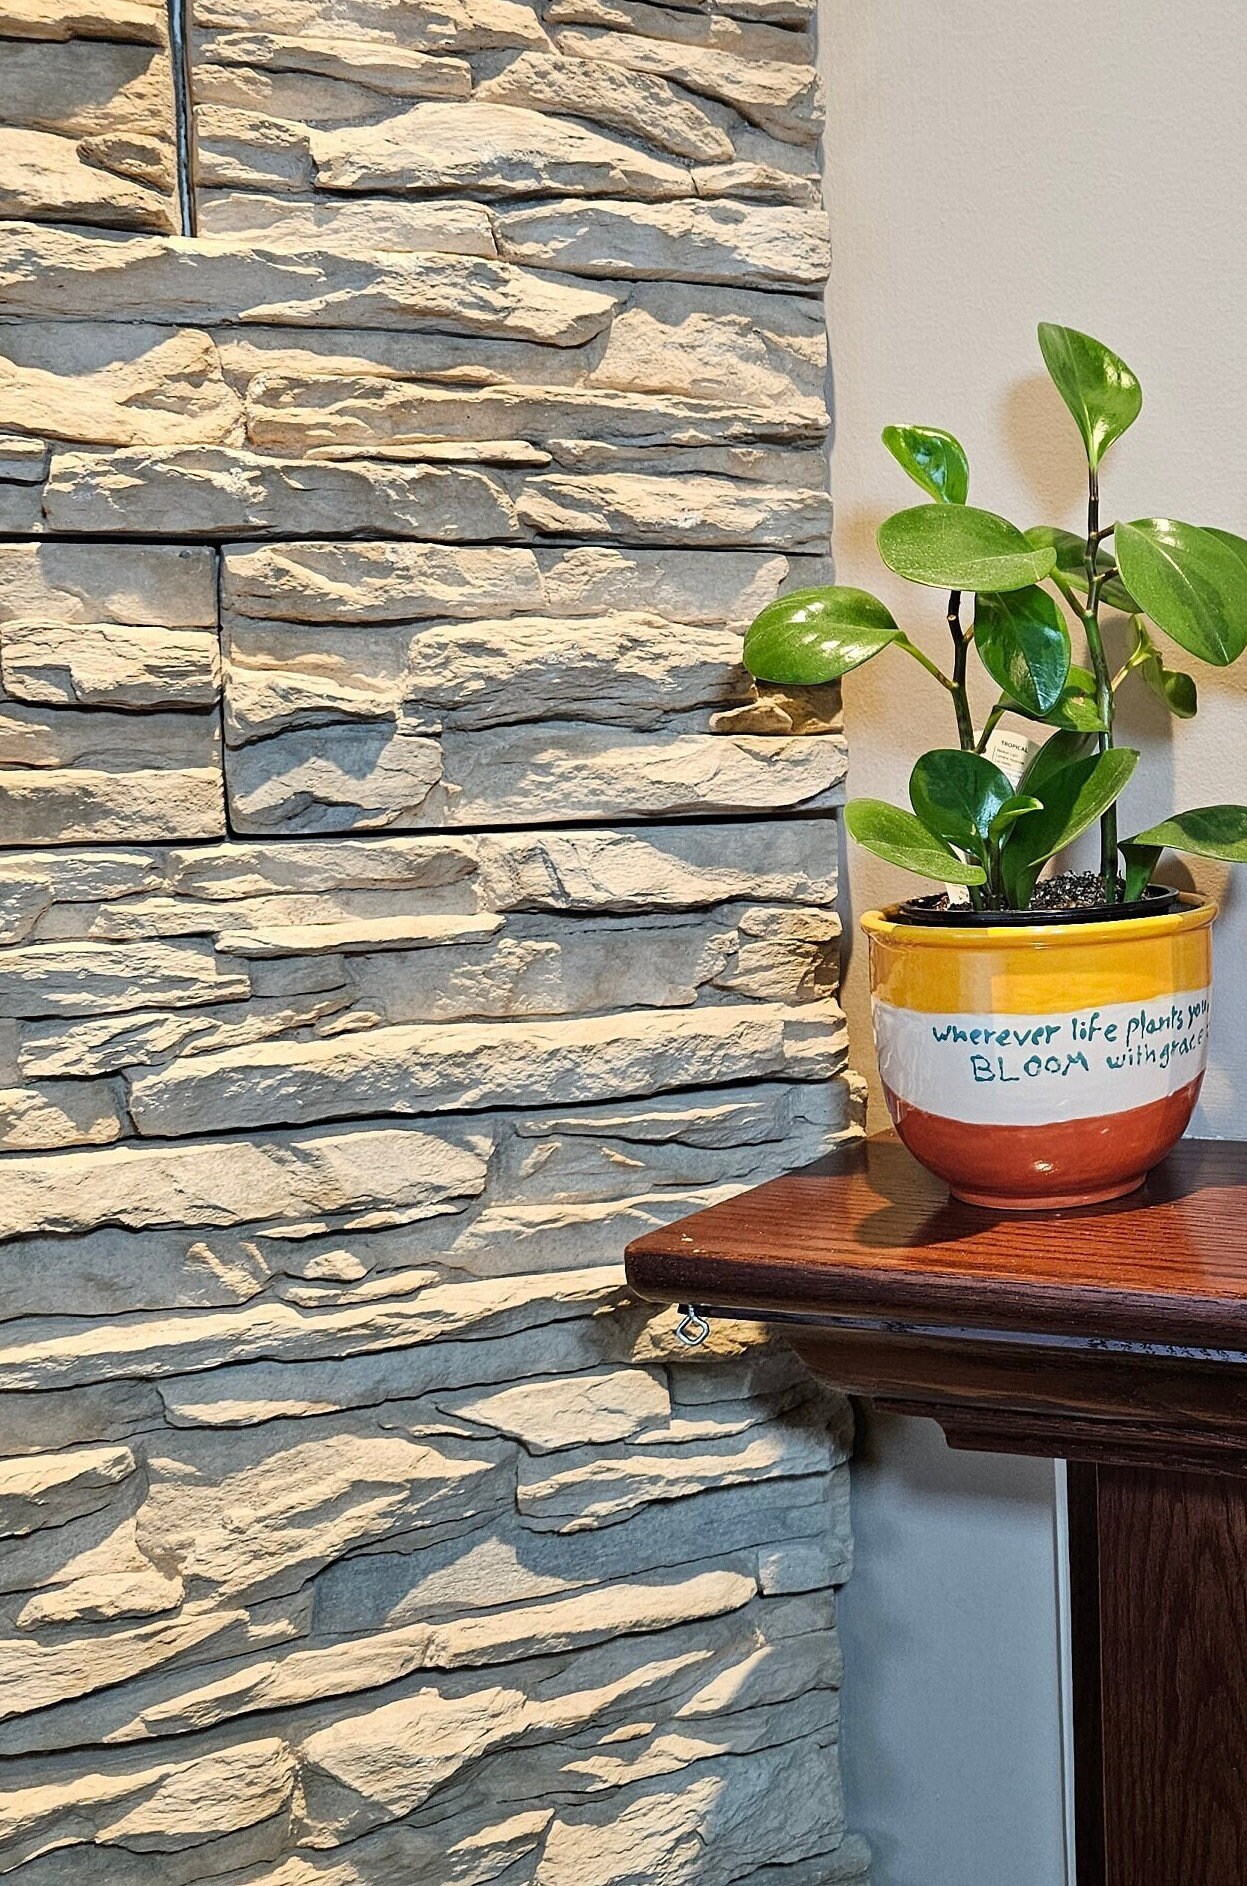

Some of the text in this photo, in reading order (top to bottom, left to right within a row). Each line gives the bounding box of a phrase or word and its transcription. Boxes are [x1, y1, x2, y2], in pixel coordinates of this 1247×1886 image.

[1001, 740, 1029, 754] TROPICAL
[932, 1023, 1062, 1047] wherever
[1071, 1011, 1118, 1042] life
[1125, 1004, 1184, 1048] plants
[970, 1053, 1090, 1083] BLOOM
